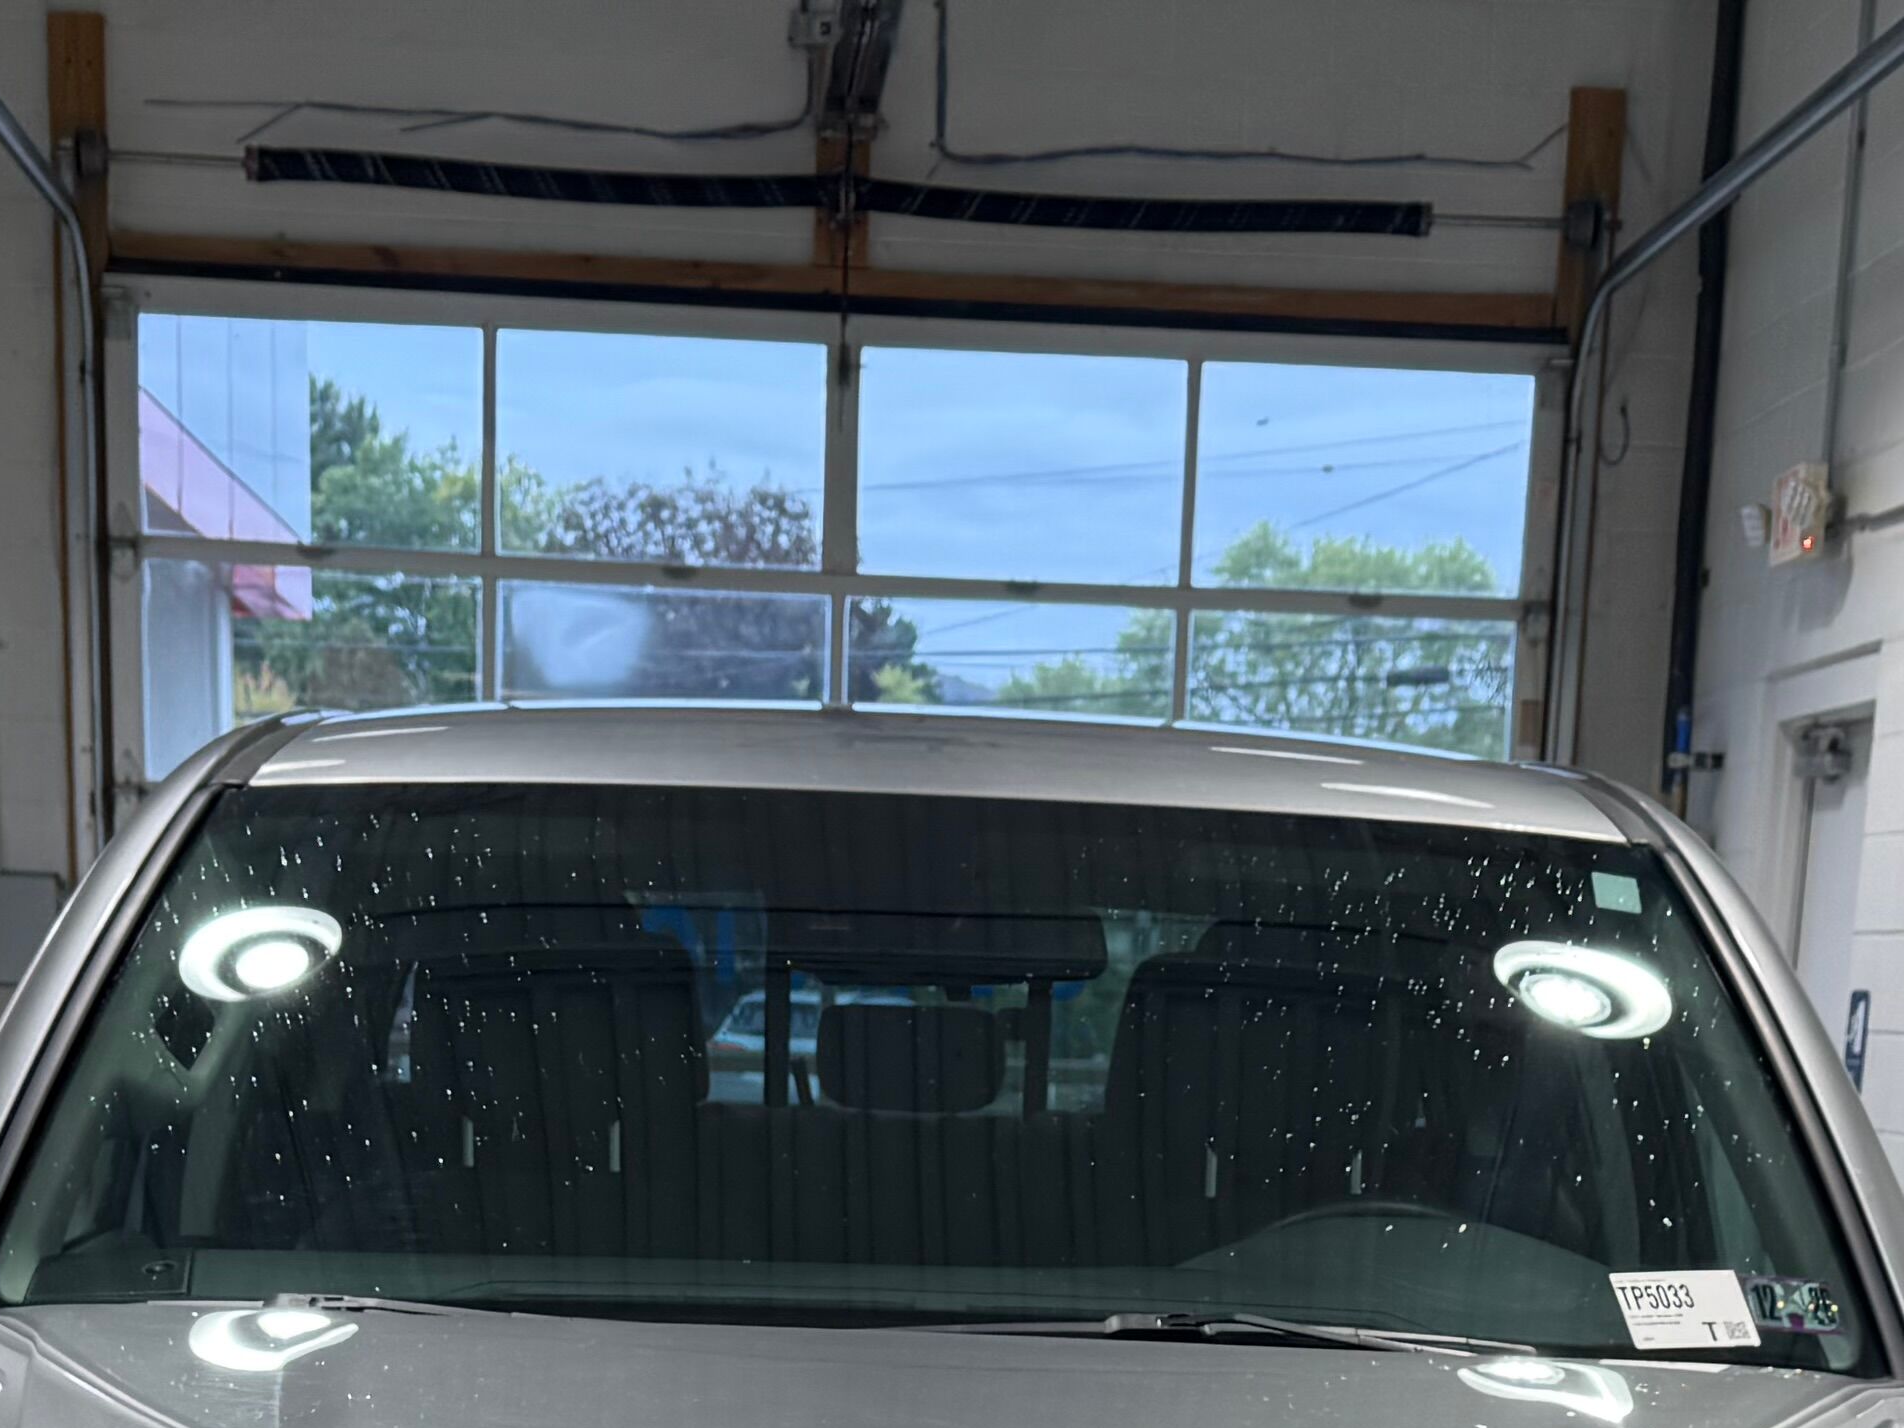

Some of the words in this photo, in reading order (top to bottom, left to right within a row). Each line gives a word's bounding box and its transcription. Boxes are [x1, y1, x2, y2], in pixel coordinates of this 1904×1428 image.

[1616, 1284, 1695, 1311] TP5033
[1751, 1284, 1782, 1321] 12
[1702, 1321, 1718, 1341] T
